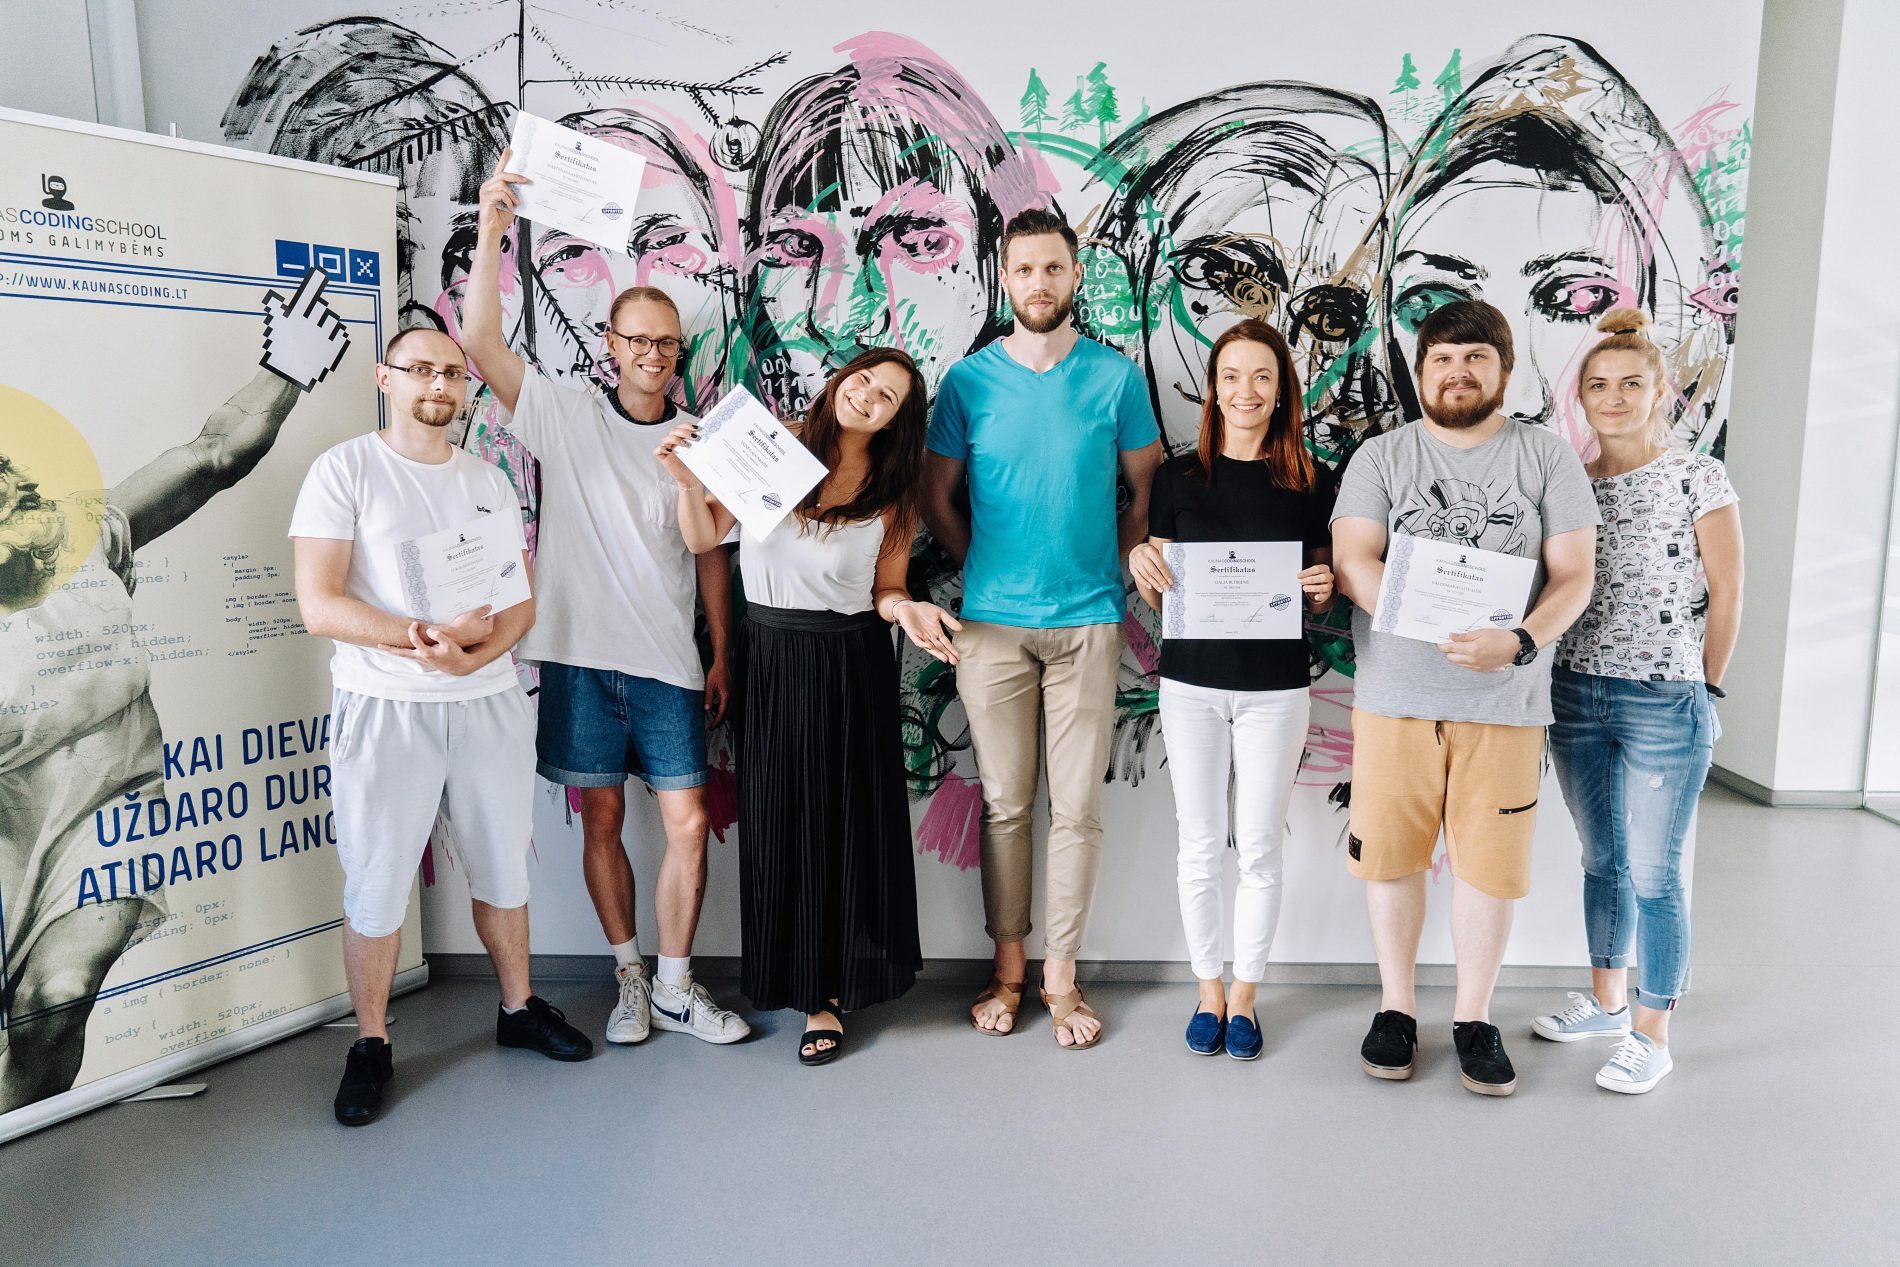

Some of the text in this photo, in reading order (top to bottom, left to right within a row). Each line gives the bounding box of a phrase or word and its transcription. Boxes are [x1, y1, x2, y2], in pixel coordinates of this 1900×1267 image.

[49, 234, 164, 257] GALIMYBĖMS
[1209, 565, 1256, 574] Sertifikatas
[1435, 566, 1484, 583] Sertifikatas
[35, 622, 157, 644] width: 520px;
[36, 634, 192, 660] overflow: hidden;
[37, 647, 210, 677] overflow-x: hidden;
[163, 733, 224, 780] KAI
[95, 763, 332, 848] UŽDARO DUR
[77, 833, 243, 909] ATIDARO
[195, 899, 226, 914] 0px;
[204, 911, 236, 926] 0px;
[122, 995, 148, 1010] img
[173, 969, 231, 993] border:
[238, 955, 277, 972] none;
[159, 999, 264, 1042] width: 520px;
[104, 1025, 141, 1045] body
[160, 1022, 233, 1055] overflow:
